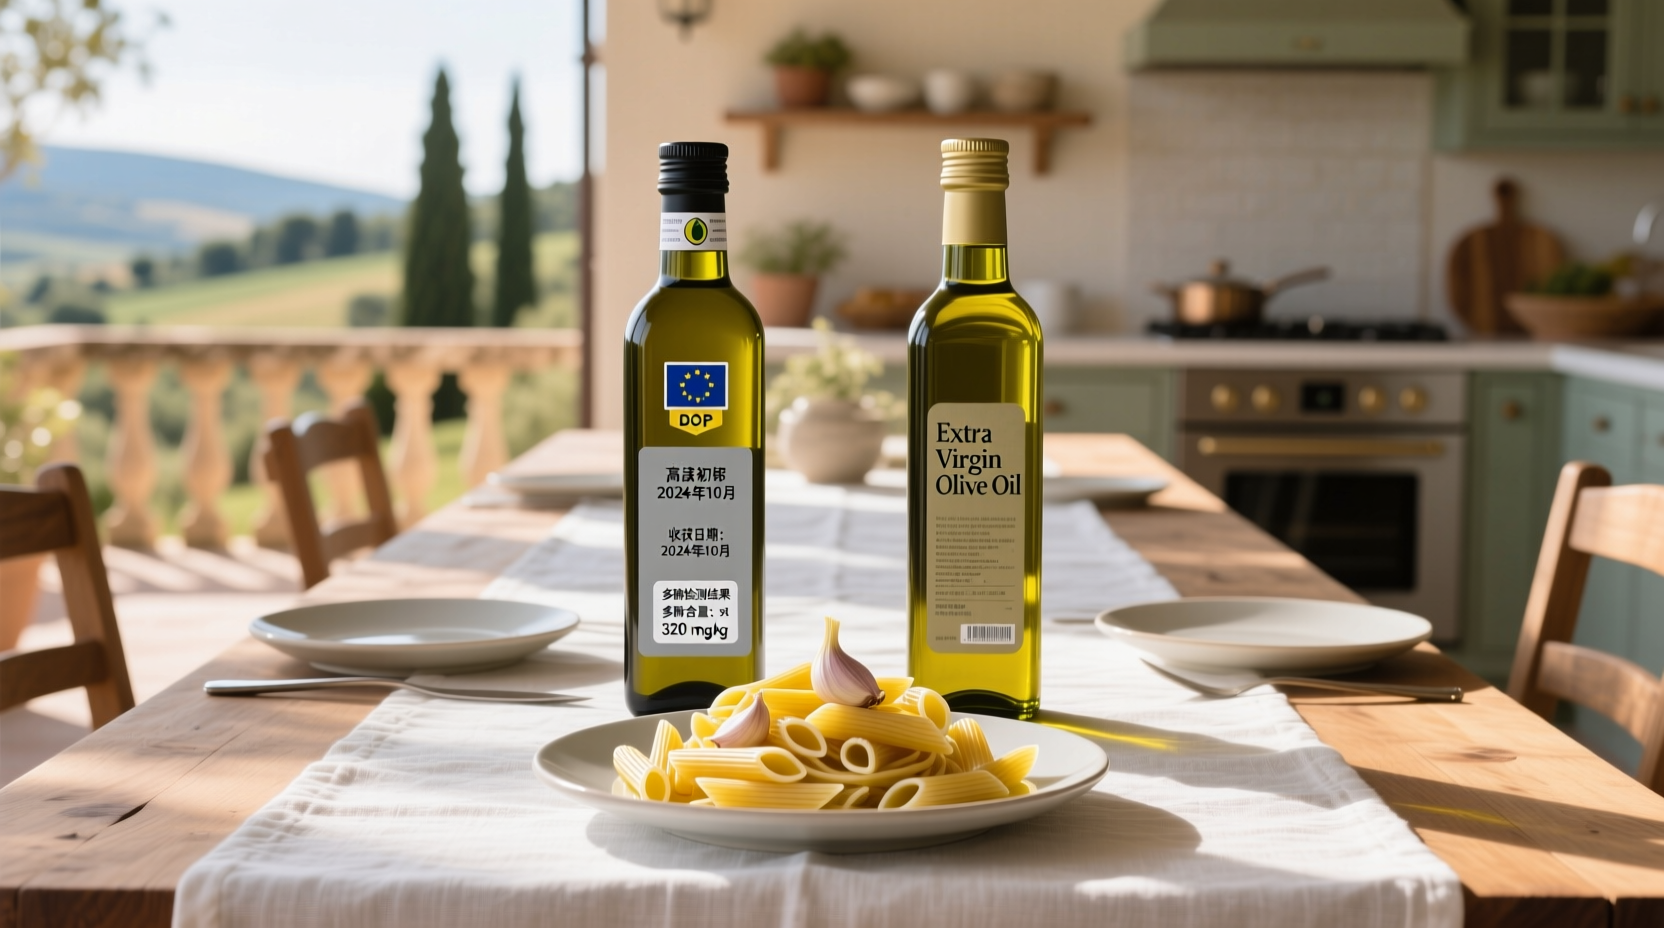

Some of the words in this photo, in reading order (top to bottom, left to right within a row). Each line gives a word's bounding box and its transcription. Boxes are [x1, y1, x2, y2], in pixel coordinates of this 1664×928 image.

[679, 413, 713, 427] DOP
[936, 422, 992, 443] Extra
[935, 448, 1002, 475] Virgin
[935, 473, 988, 495] Olive
[991, 473, 1021, 495] Oil
[657, 485, 735, 501] 2024年10月
[661, 543, 730, 557] 2024年10月
[661, 622, 687, 636] 320
